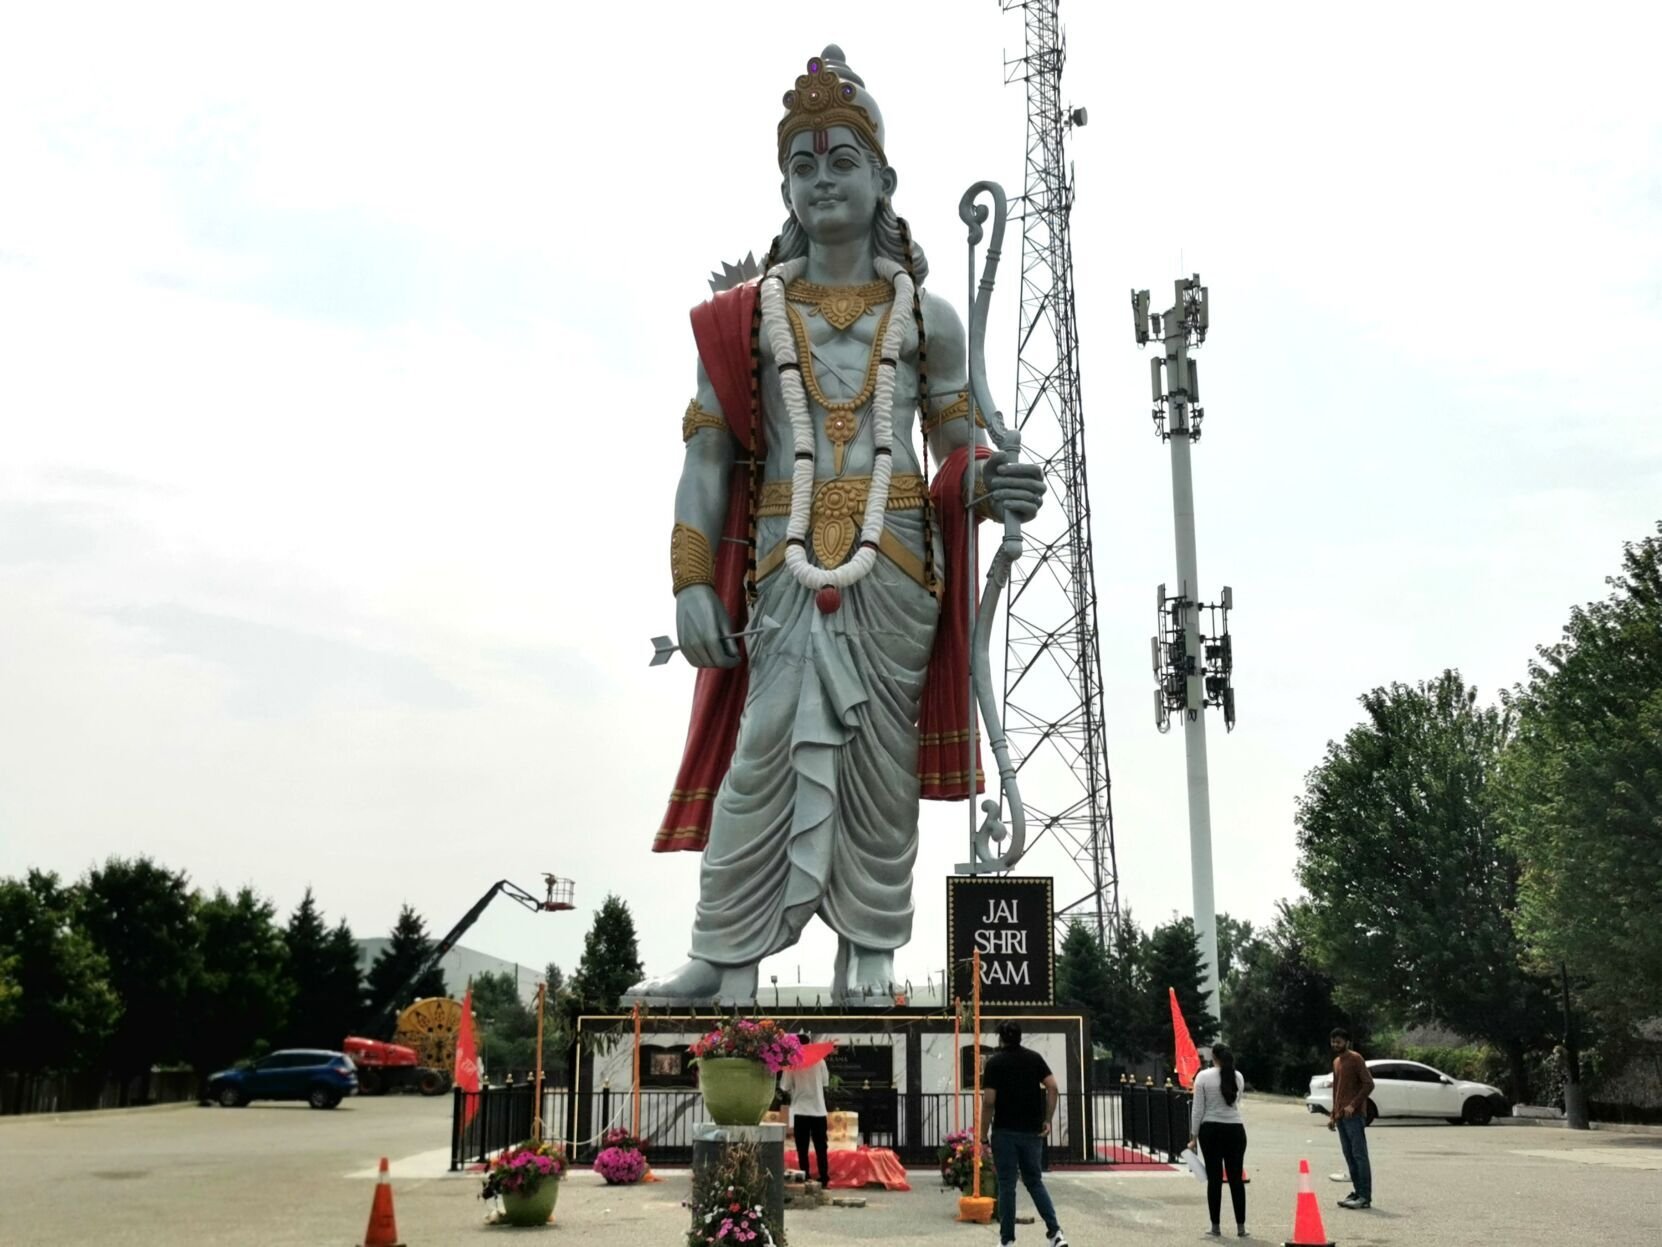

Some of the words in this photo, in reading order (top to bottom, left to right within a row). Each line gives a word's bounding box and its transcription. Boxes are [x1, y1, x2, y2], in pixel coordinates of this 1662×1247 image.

[982, 899, 1018, 923] JAI
[974, 929, 1028, 954] SHRI
[977, 960, 1031, 985] RAM
